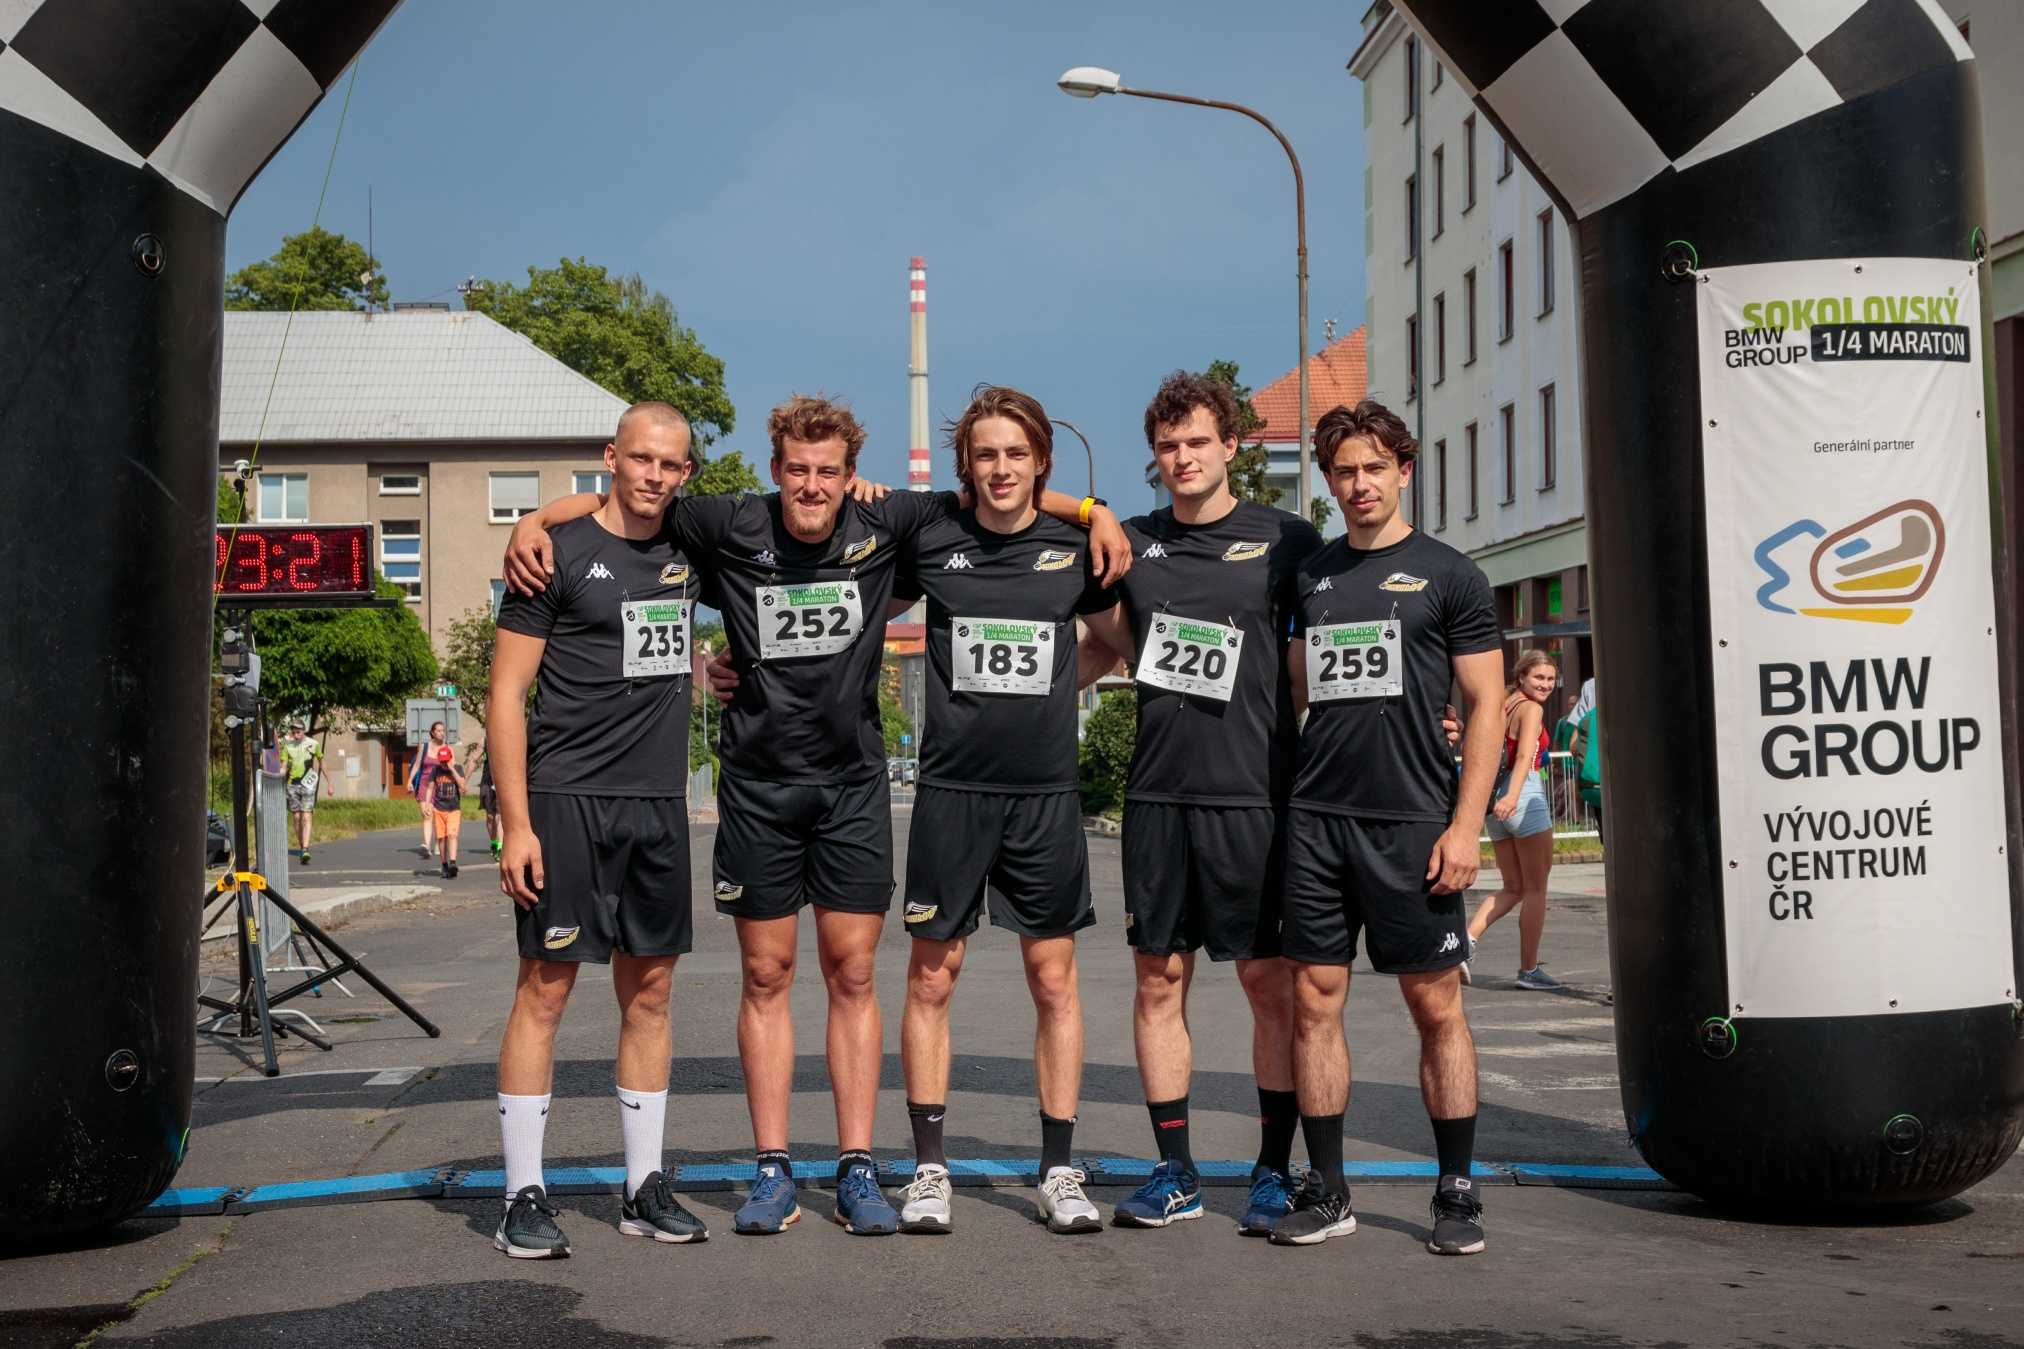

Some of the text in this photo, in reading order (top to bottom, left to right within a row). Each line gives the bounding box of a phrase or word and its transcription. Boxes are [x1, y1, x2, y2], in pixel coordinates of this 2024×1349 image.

[1743, 287, 1960, 334] SOKOLOVSKÝ
[1725, 326, 1784, 348] BMW
[1822, 330, 1965, 356] 1/4 MARATON
[1725, 345, 1808, 368] GROUP
[1813, 439, 1915, 453] Generální partner
[637, 624, 685, 658] 235
[775, 606, 851, 641] 252
[982, 623, 1037, 634] SOKOLOVSKÝ
[968, 643, 1038, 677] 183
[1154, 640, 1227, 680] 220
[1319, 646, 1389, 682] 259
[1758, 656, 1932, 716] BMW
[1761, 717, 1981, 780] GROUP
[1763, 800, 1933, 843] VÝVOJOVÉ
[1767, 846, 1927, 882] CENTRUM
[1768, 884, 1814, 920] ČR
